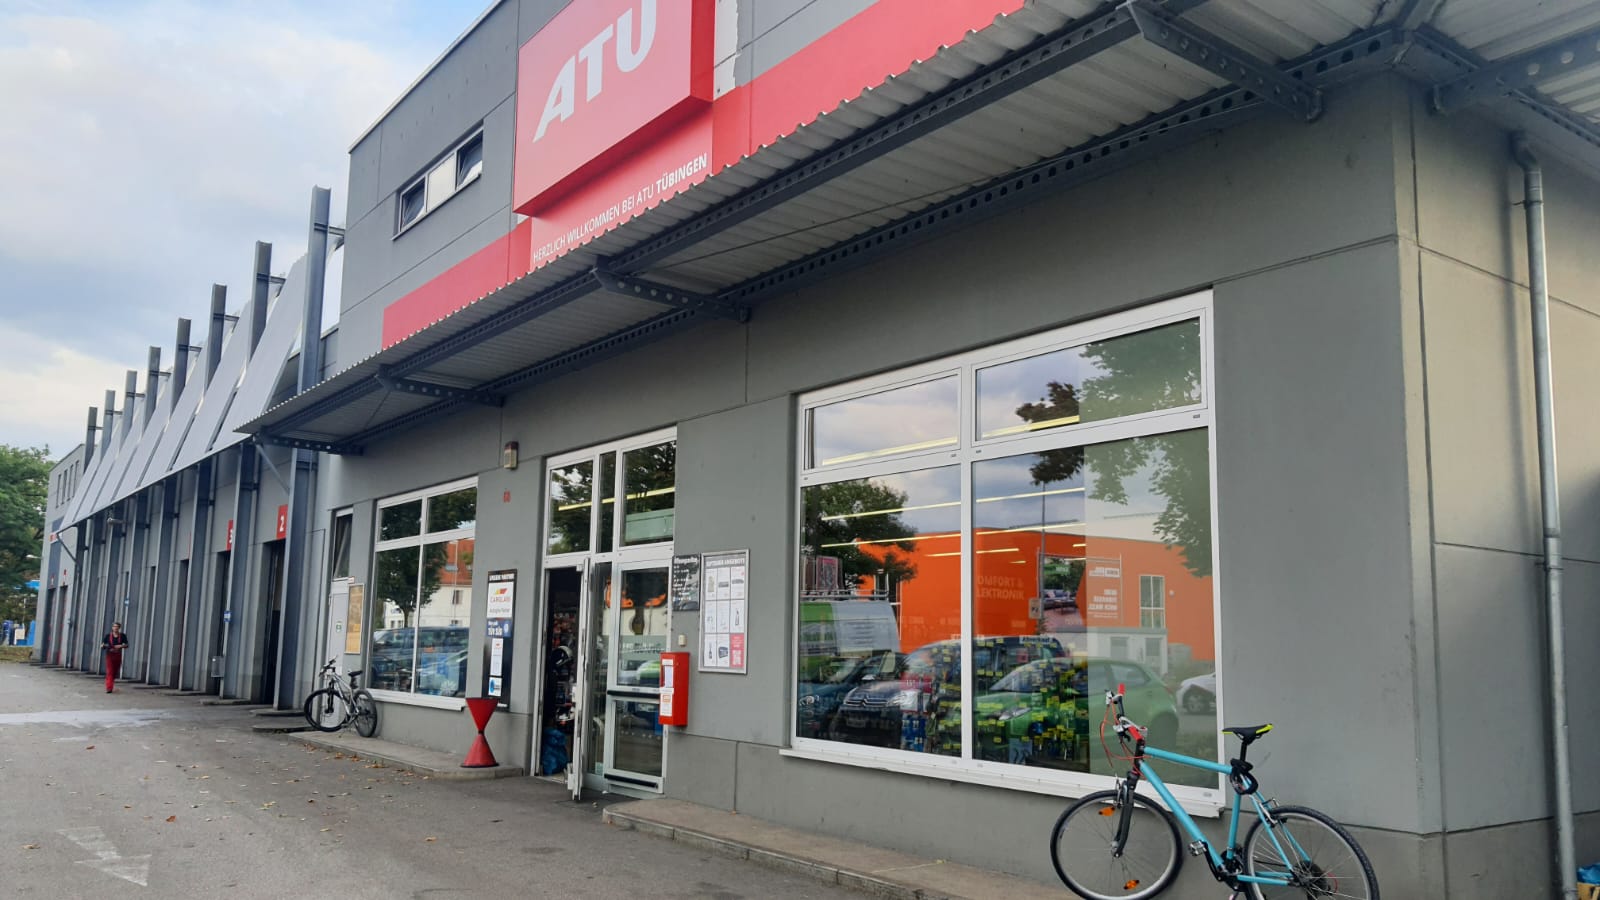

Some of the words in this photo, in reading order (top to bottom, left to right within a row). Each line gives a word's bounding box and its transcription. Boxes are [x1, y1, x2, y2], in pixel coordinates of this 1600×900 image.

[533, 0, 656, 143] ATU
[533, 236, 566, 263] HERZLICH
[567, 203, 620, 245] WILLKOMMEN
[621, 194, 635, 215] BEI
[636, 184, 654, 206] ATU
[655, 152, 708, 194] TÜBINGEN
[279, 515, 285, 532] 2
